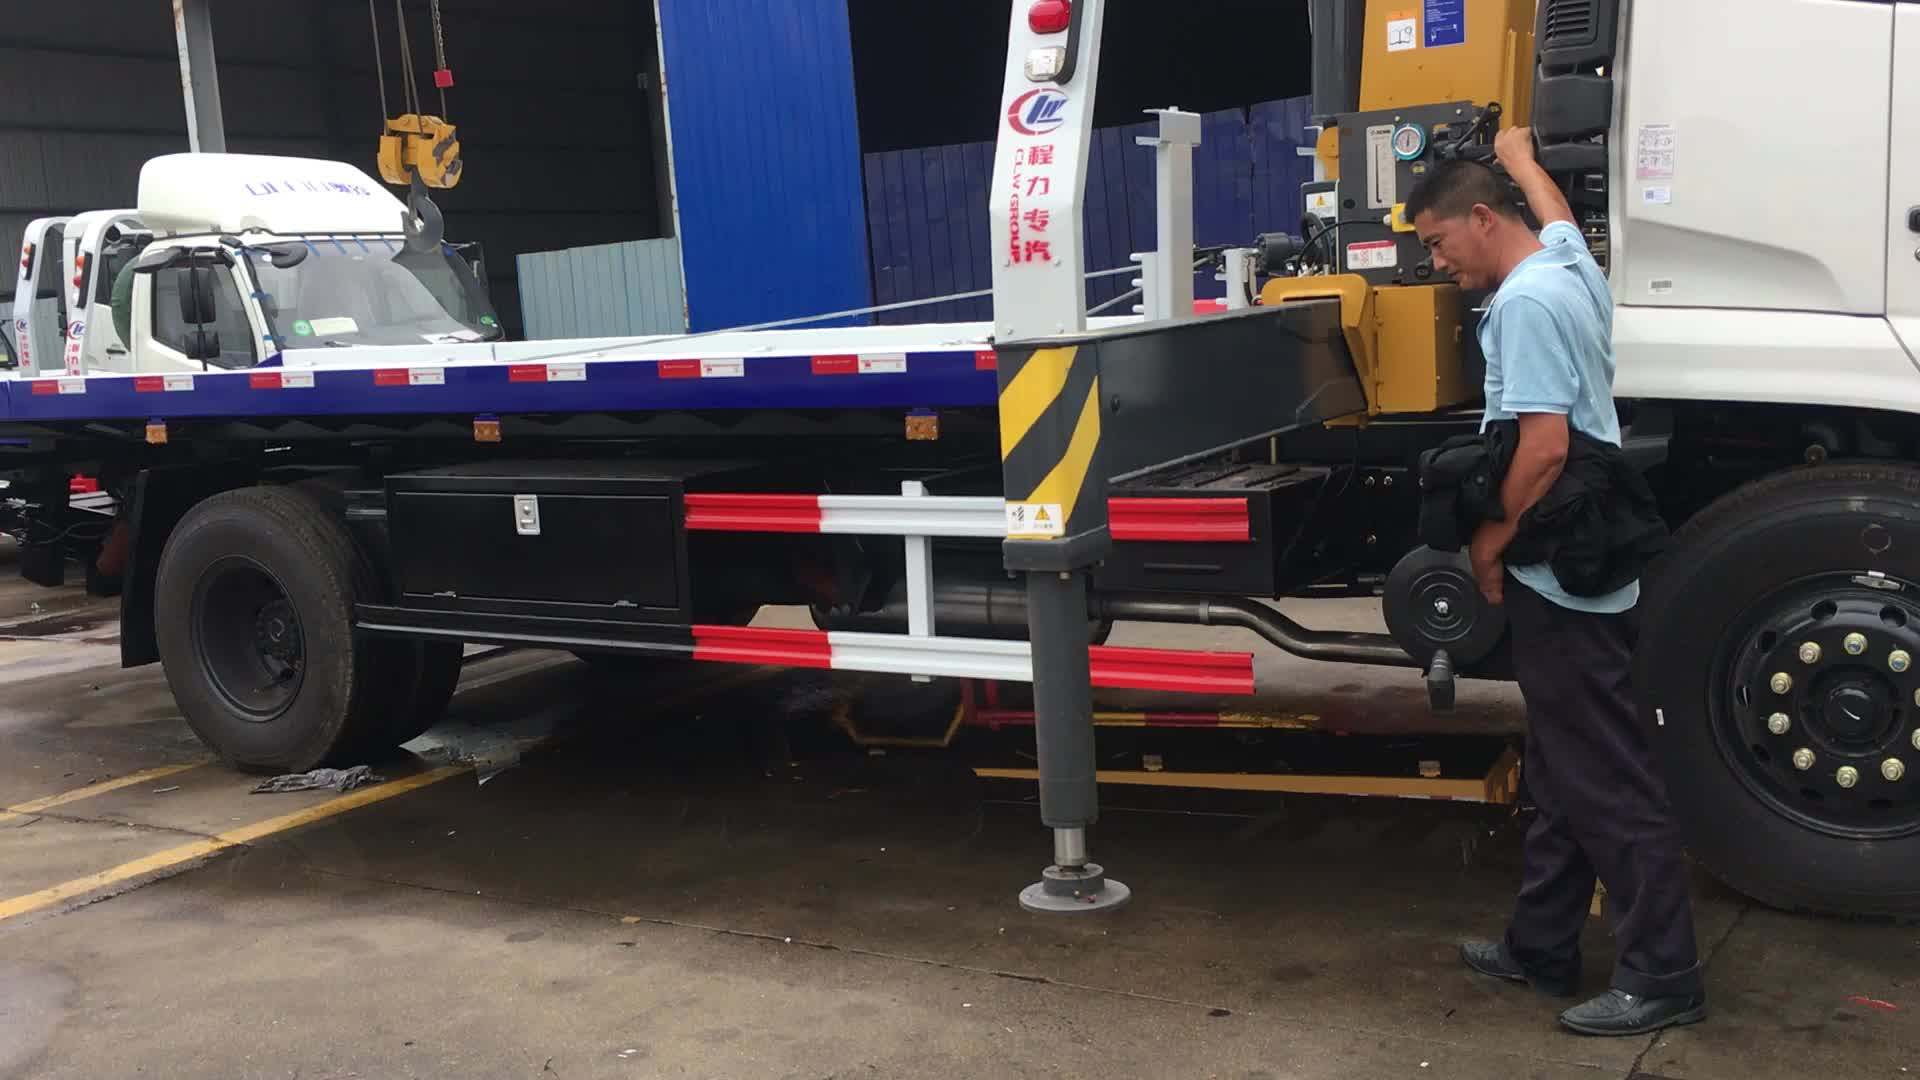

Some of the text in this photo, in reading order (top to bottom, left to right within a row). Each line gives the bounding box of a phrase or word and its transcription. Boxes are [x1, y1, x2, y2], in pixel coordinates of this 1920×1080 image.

[1009, 193, 1020, 264] GROUP
[1023, 144, 1053, 262] 程力专汽
